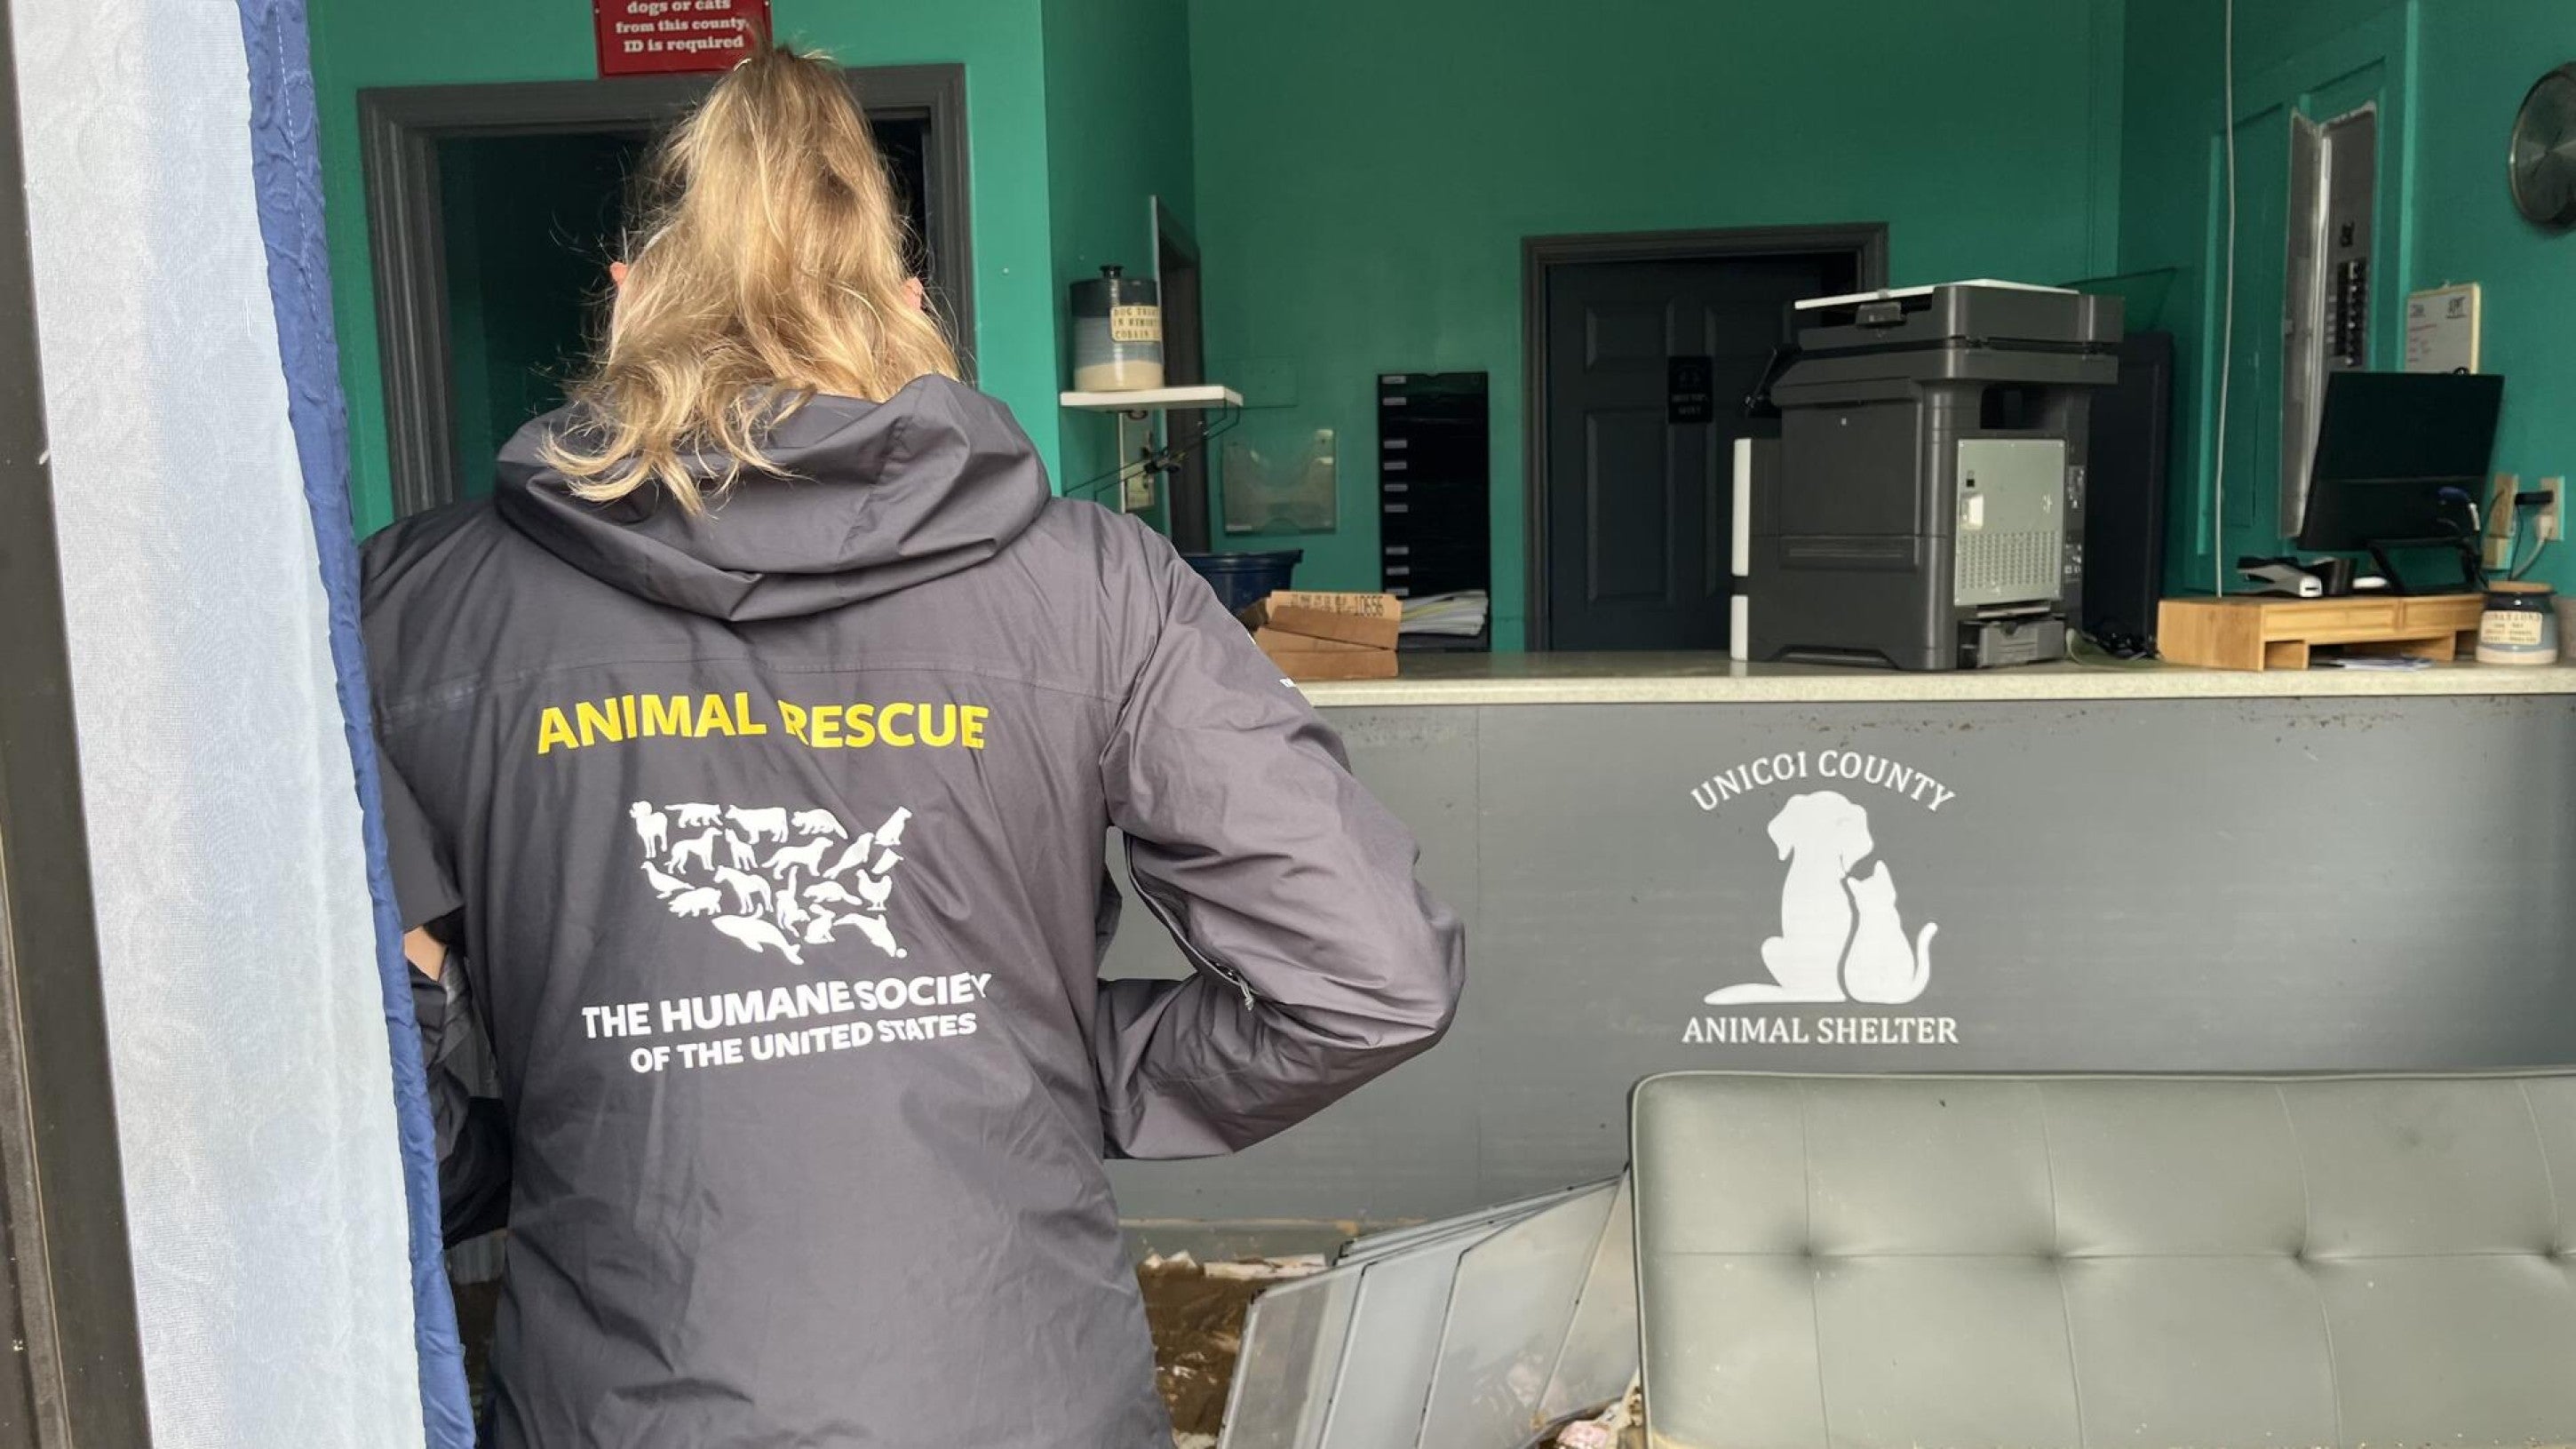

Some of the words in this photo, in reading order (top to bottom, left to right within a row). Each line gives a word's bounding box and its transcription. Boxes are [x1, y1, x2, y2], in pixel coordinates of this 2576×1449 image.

[616, 21, 655, 34] from
[658, 20, 689, 32] this
[627, 0, 668, 16] dogs
[672, 0, 692, 11] or
[696, 0, 731, 11] cats
[624, 40, 644, 52] ID
[648, 38, 664, 52] is
[667, 36, 744, 52] required
[537, 692, 767, 753] ANIMAL
[777, 699, 989, 749] RESCUE
[1690, 751, 1807, 811] UNICOI
[1818, 749, 1956, 811] COUNTY
[581, 1002, 651, 1039] THE
[659, 980, 855, 1032] HUMANE
[854, 971, 992, 1011] SOCIEY
[630, 1046, 671, 1073] OF
[676, 1038, 743, 1069] THE
[750, 1022, 873, 1061] UNITED
[876, 1012, 977, 1043] STATES
[1682, 1016, 1809, 1044] ANIMAL
[1817, 1016, 1960, 1045] SHELTER
